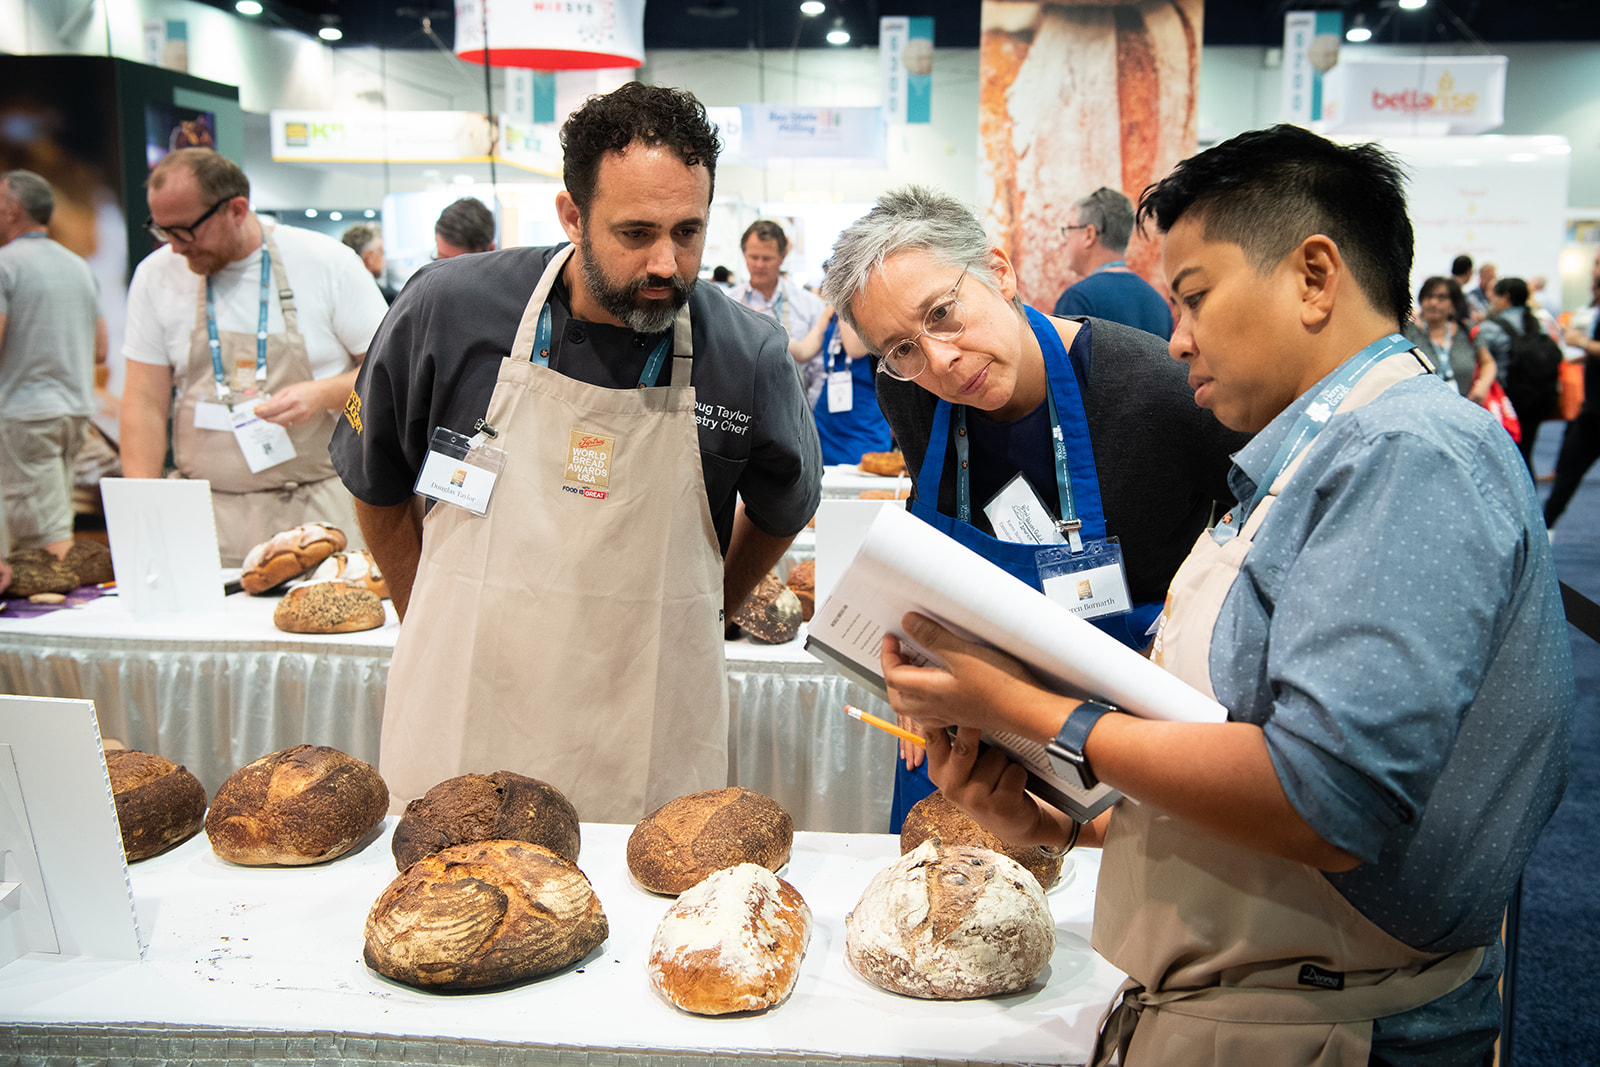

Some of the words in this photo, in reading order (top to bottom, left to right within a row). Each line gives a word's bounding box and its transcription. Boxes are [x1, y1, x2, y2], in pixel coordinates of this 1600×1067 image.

[695, 401, 714, 416] oug
[716, 405, 752, 424] Taylor
[695, 415, 719, 430] stry
[720, 419, 750, 436] Chef
[572, 447, 608, 461] WORLD
[572, 455, 605, 469] BREAD
[567, 463, 608, 478] AWARDS
[577, 473, 597, 484] USA
[430, 482, 456, 496] Douglas
[456, 491, 477, 503] Taylor
[562, 485, 578, 494] FOOD
[584, 490, 605, 499] GREAT
[1068, 605, 1083, 614] ren
[1083, 597, 1116, 611] Bornarth
